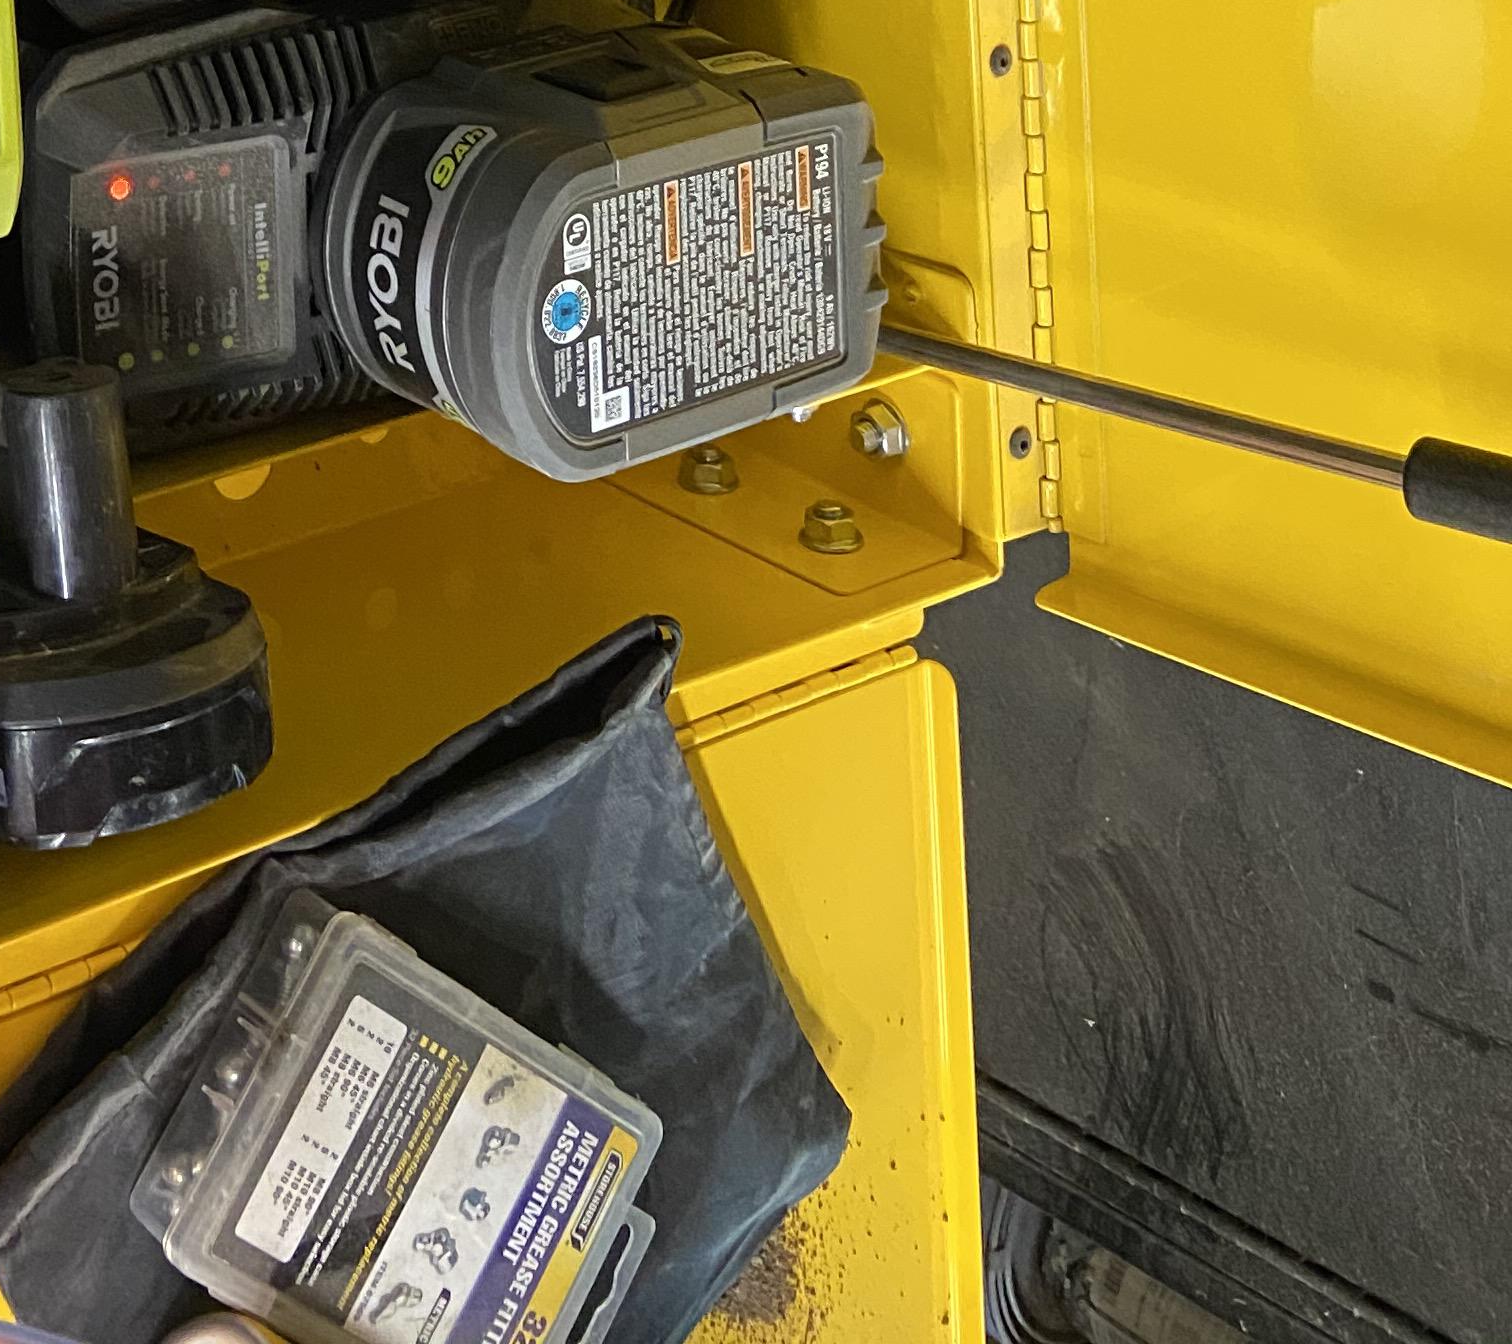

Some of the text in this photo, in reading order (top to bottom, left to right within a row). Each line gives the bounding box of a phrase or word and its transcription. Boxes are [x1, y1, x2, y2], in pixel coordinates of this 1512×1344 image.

[432, 127, 488, 190] 9Ah
[813, 142, 829, 180] P194
[820, 185, 831, 214] LI-ION
[253, 201, 269, 302] IntelliPort
[90, 224, 120, 331] RYOBI
[366, 194, 416, 373] RYOBI
[345, 1017, 357, 1028] 2
[364, 1030, 376, 1039] 2
[374, 1036, 385, 1045] 2
[342, 1087, 370, 1130] straight
[404, 1106, 433, 1151] grease
[299, 1133, 310, 1143] 2
[309, 1139, 320, 1149] 2
[503, 1121, 577, 1265] ASSORTMENT
[549, 1133, 599, 1213] METRIC
[275, 1194, 304, 1238] straight
[579, 1164, 617, 1231] STOREHOUSE
[509, 1215, 560, 1298] GREASE
